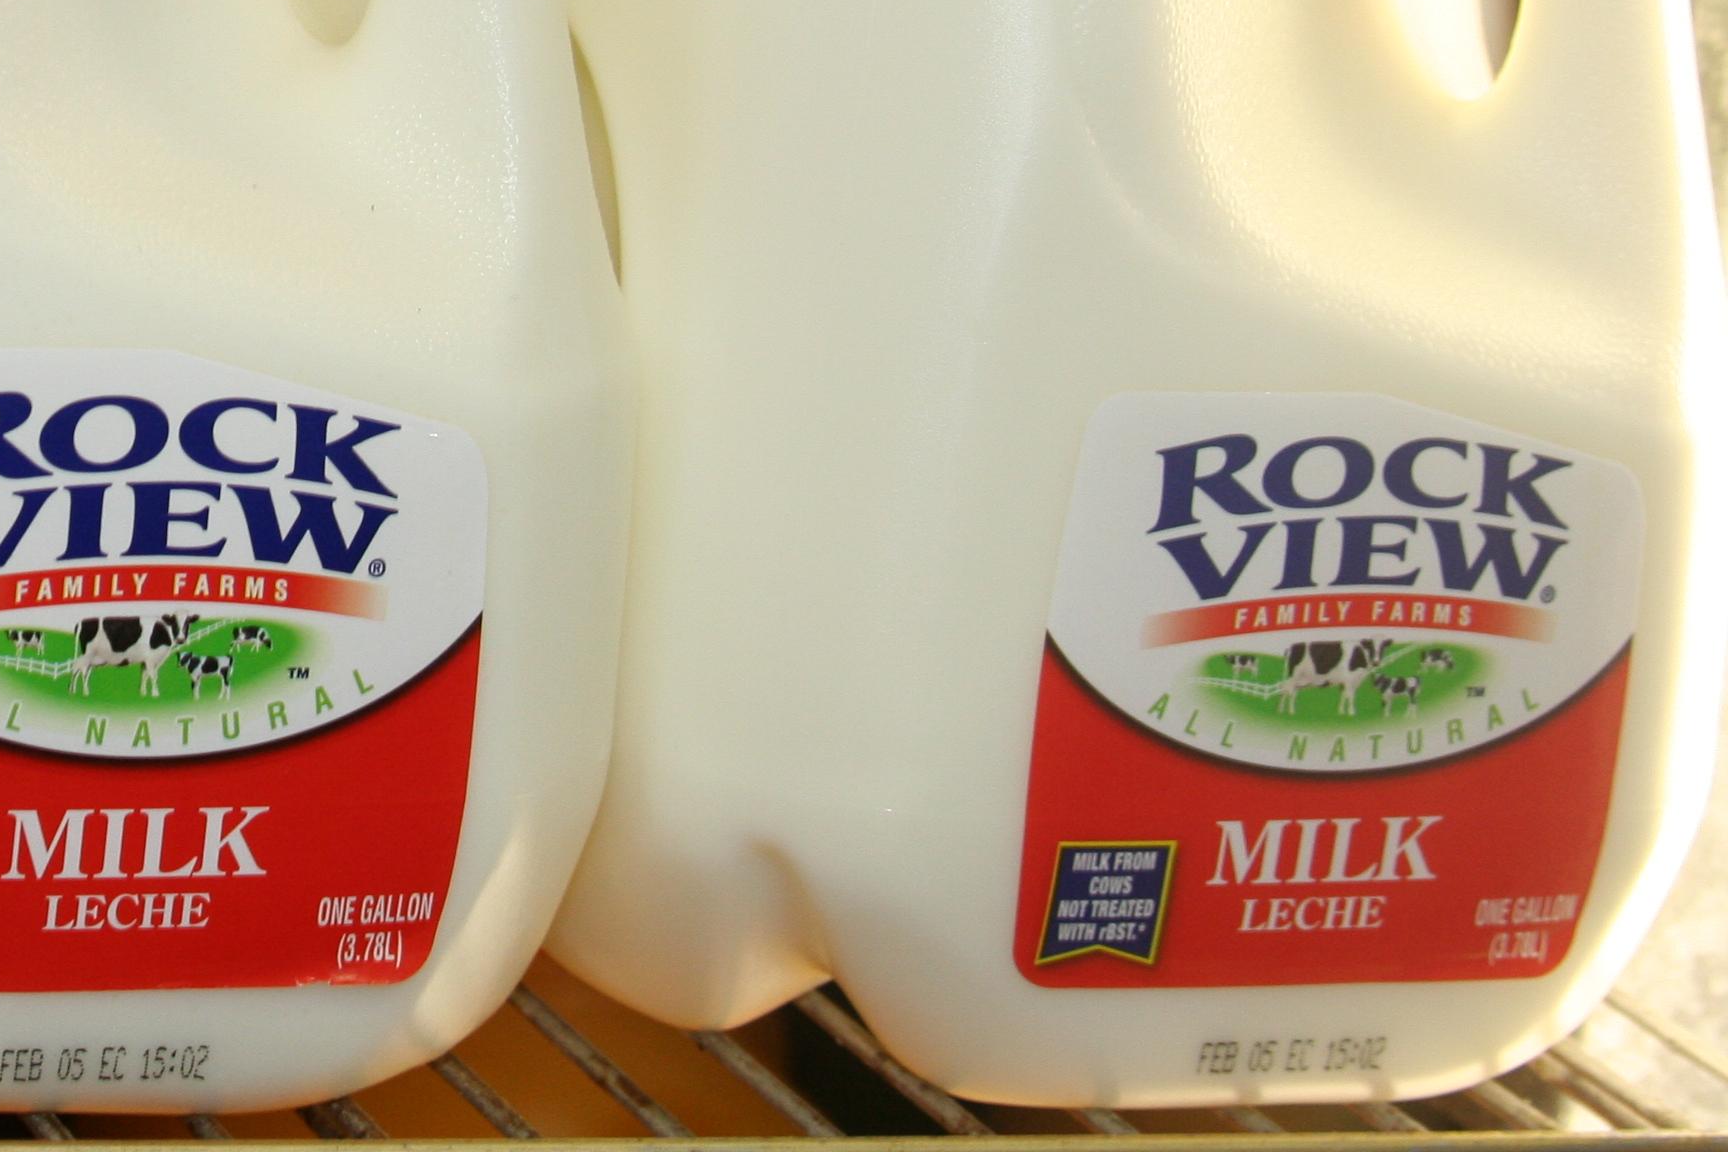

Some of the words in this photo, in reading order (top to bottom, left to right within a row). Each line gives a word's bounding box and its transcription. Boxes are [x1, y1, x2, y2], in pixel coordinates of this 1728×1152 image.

[1147, 432, 1574, 534] ROCK
[1156, 515, 1569, 603] VIEW
[14, 572, 148, 604] FAMILY
[172, 571, 290, 602] FARMS
[1234, 600, 1351, 630] FAMILY
[1372, 599, 1473, 627] FARMS
[85, 667, 375, 749] NATURAL
[1148, 691, 1233, 749] ALL
[1288, 688, 1540, 763] NATURAL
[0, 806, 269, 881] MILK
[1072, 852, 1112, 871] MILK
[1113, 851, 1158, 871] FROM
[1205, 814, 1443, 886] MILK
[1088, 876, 1133, 895] COWS
[42, 892, 211, 933] LECHE
[318, 895, 357, 926] ONE
[360, 892, 434, 924] GALLON
[1057, 899, 1089, 918] NOT
[1090, 898, 1155, 918] TREATED
[1238, 894, 1387, 932] LECHE
[337, 930, 402, 969] (3.78L)
[1058, 922, 1097, 941] WITH
[0, 1048, 44, 1082] FEB
[57, 1048, 88, 1081] 05
[98, 1046, 127, 1080] EC
[140, 1045, 210, 1080] 15:02
[1196, 1041, 1239, 1074] FEB
[1285, 1039, 1315, 1071] EC
